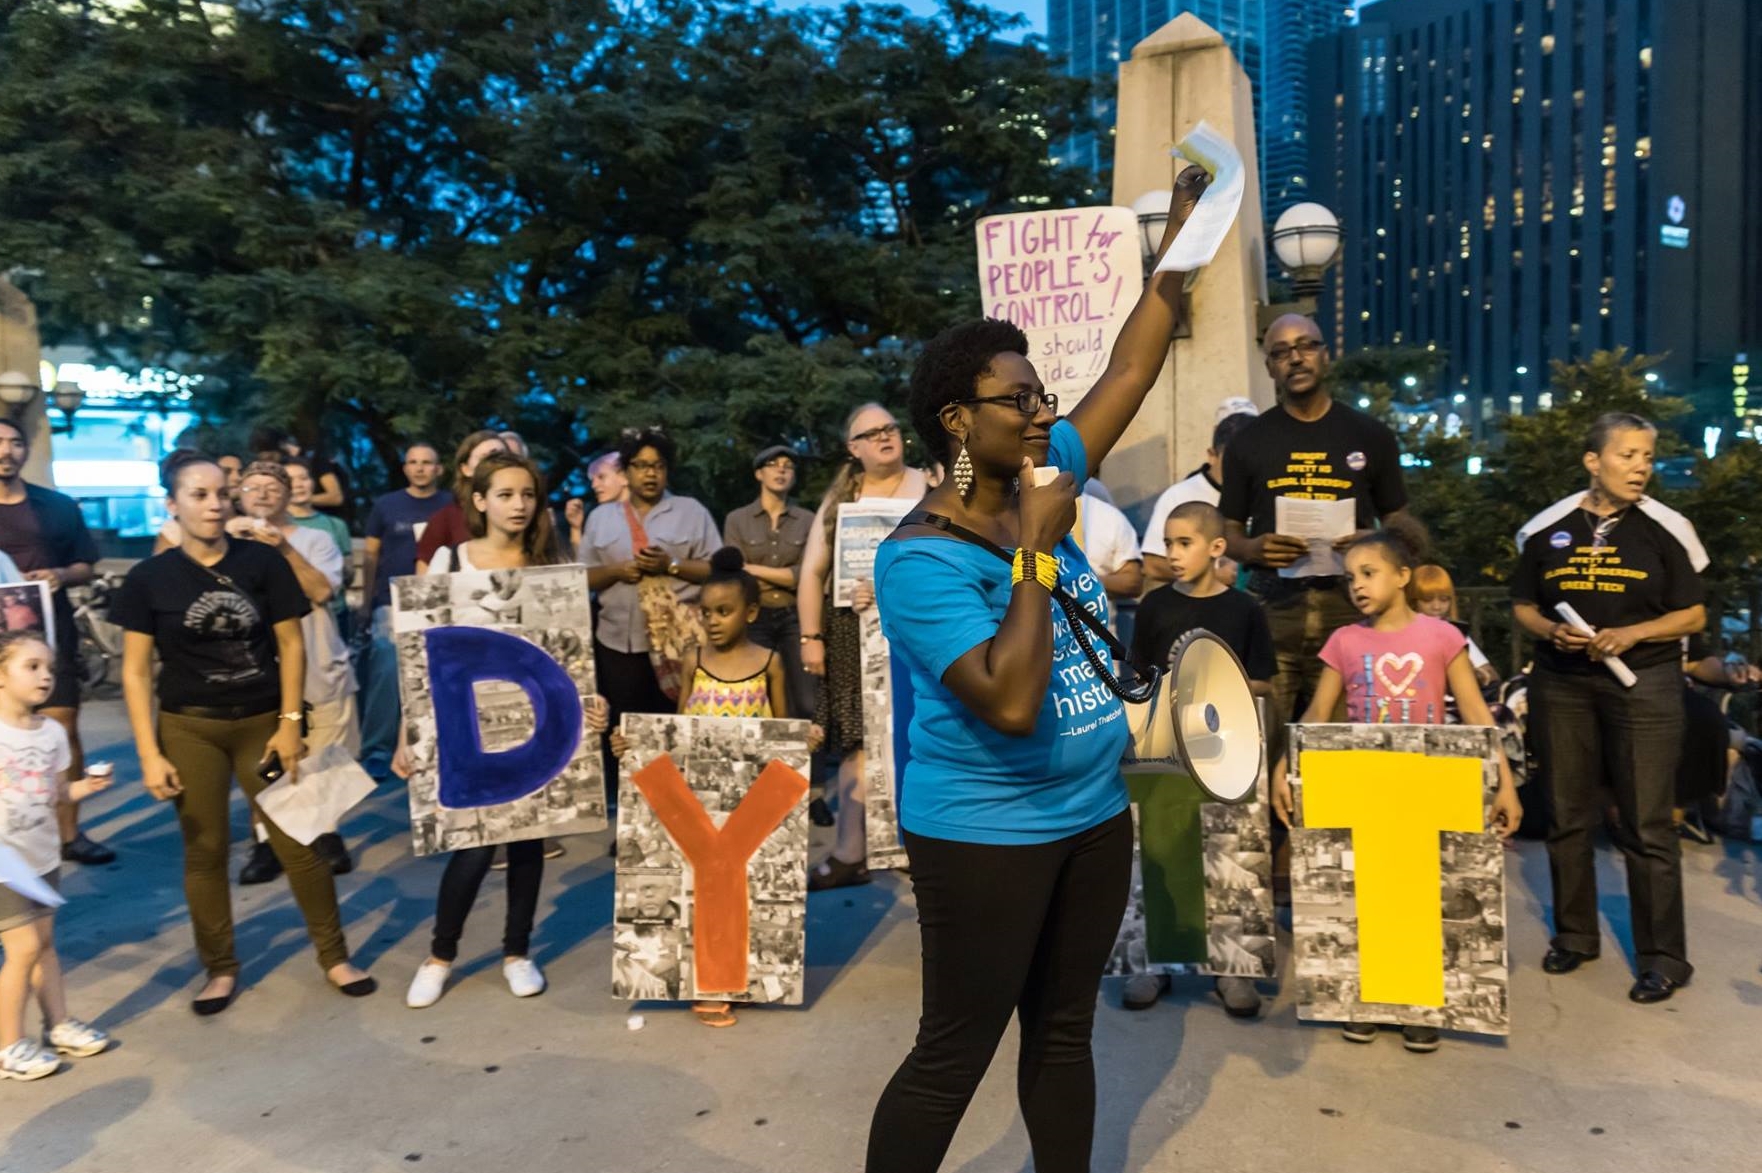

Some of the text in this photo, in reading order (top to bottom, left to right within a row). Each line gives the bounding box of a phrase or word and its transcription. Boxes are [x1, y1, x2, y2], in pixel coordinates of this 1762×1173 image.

[984, 213, 1123, 259] FIGHT for
[988, 251, 1111, 297] PEOPLE'S
[992, 275, 1123, 328] CONTROL!
[1042, 328, 1103, 356] should
[1059, 648, 1109, 687] mae
[423, 625, 583, 810] D
[1053, 682, 1114, 718] histo
[628, 751, 809, 992] Y
[1299, 749, 1485, 1008] T
